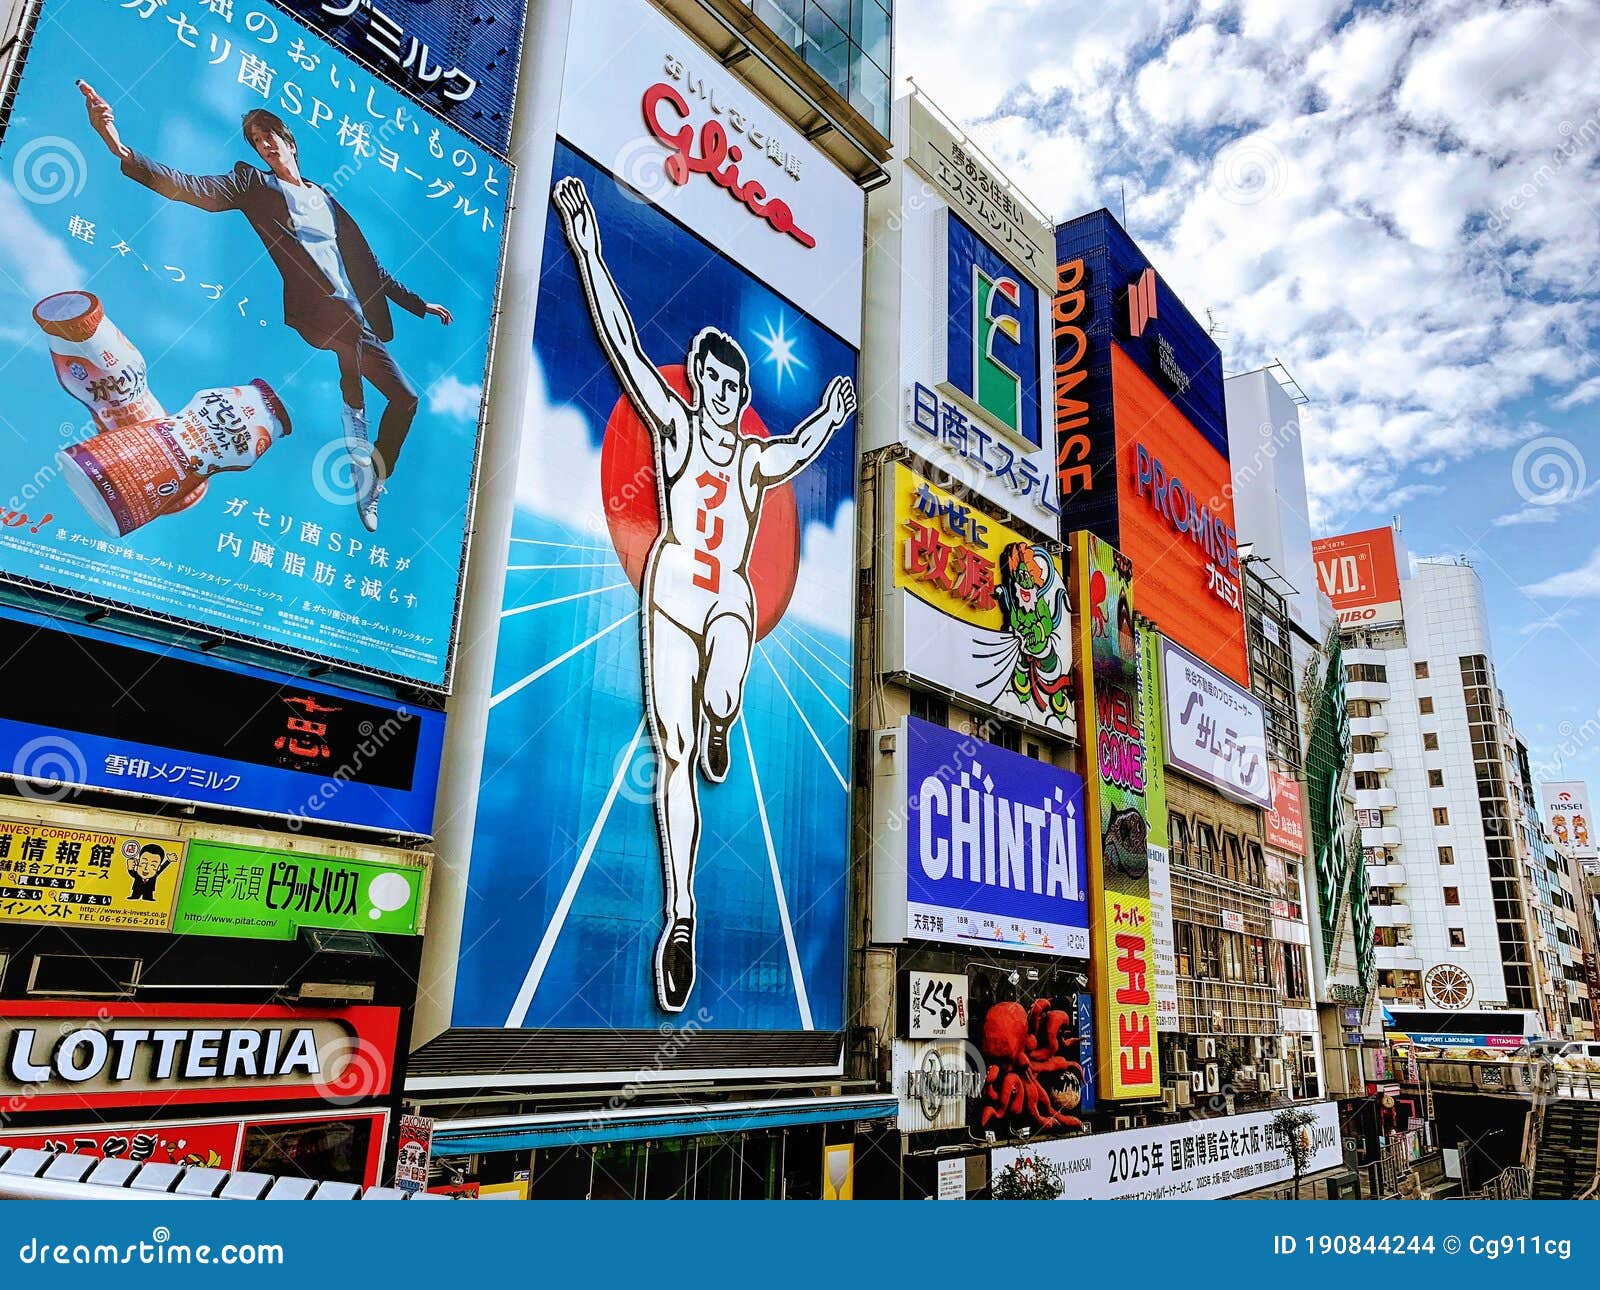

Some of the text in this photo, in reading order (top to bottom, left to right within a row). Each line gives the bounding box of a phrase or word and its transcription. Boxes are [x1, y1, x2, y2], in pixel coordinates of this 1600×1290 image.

[664, 53, 802, 182] おいしさと健康
[642, 82, 817, 249] Glico
[951, 142, 1024, 226] 夢ある住まい
[936, 160, 1037, 268] エステムシリーズ
[693, 470, 730, 594] グリコ
[915, 483, 989, 549] かぜに
[1135, 442, 1238, 578] PROMISE
[904, 518, 998, 612] 改源
[1205, 562, 1242, 613] プロミス
[104, 753, 241, 792] 雪印メグミルク
[41, 829, 117, 845] CORPORATION
[919, 760, 1079, 901] CHINTAI
[18, 876, 75, 888] 買いたい
[265, 861, 360, 916] ピタットハウス
[0, 901, 73, 919] インベスト
[78, 913, 166, 926] TEL 06-6766-2016
[80, 905, 168, 918] http://www.k-invest.co.jp
[184, 912, 277, 927] http://www.pitat.com/
[914, 913, 944, 933] 天気予報
[1113, 903, 1146, 927] スーパー
[921, 979, 957, 1028] くくる
[11, 1028, 320, 1082] LOTTERIA
[1420, 1036, 1475, 1044] AIRPORT LIMOUSINE
[1108, 1123, 1290, 1183] 2025年 国際博覧会を大阪・関西
